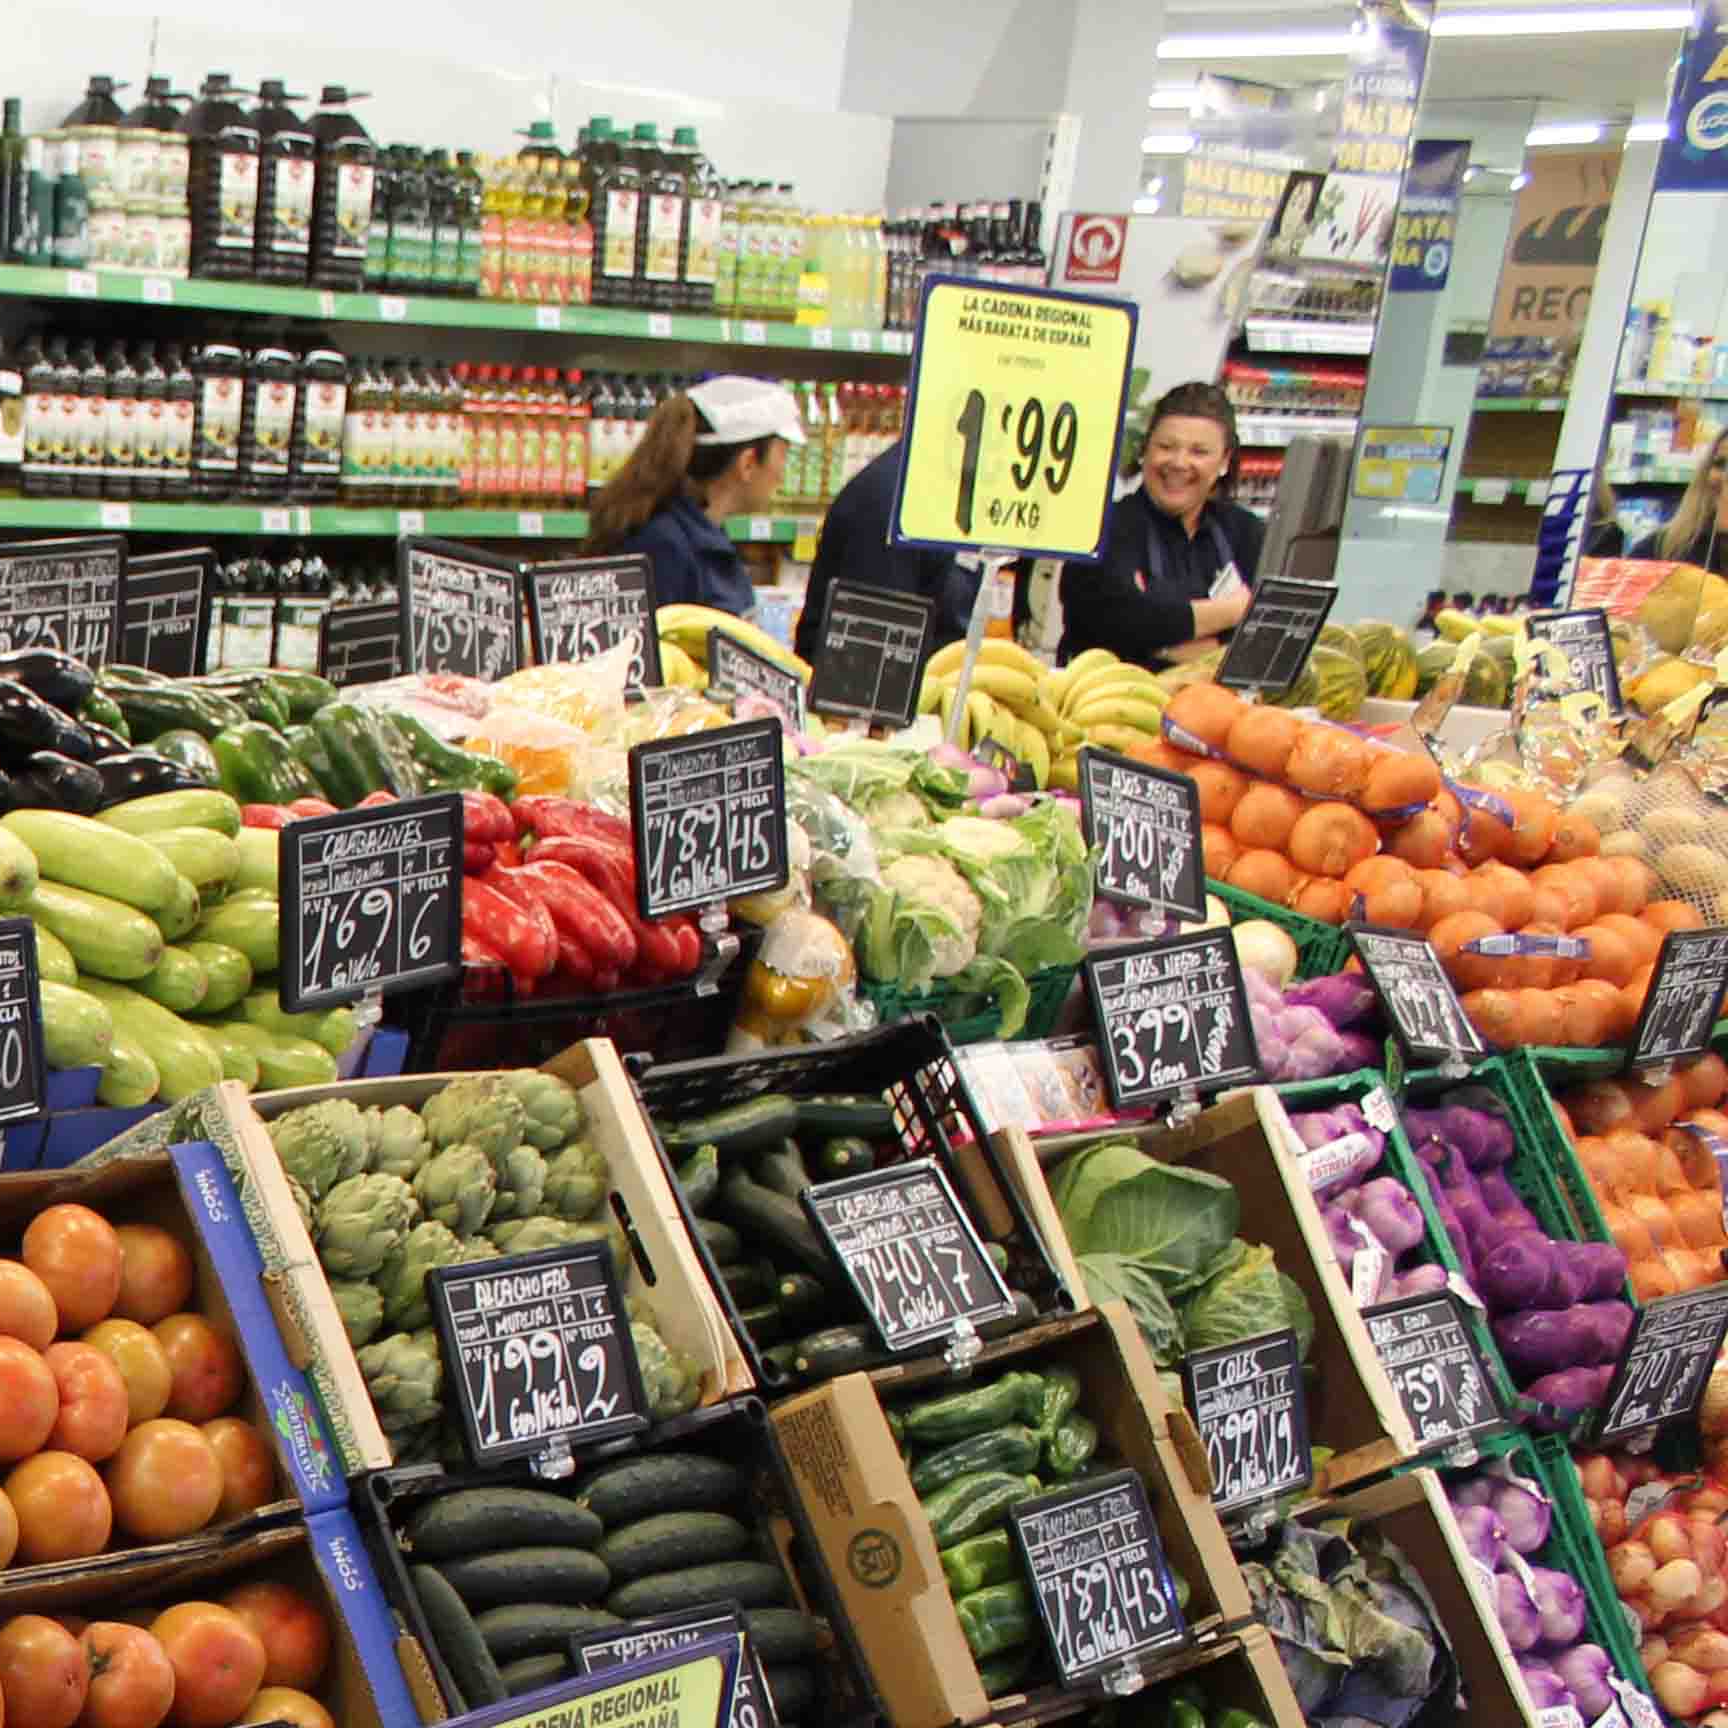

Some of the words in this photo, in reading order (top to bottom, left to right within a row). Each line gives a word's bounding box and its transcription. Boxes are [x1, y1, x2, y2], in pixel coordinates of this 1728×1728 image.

[963, 294, 978, 311] LA
[982, 299, 1032, 319] CADENA
[1035, 308, 1093, 328] REGIONAL
[984, 321, 1031, 339] BARATA
[1033, 324, 1046, 341] DE
[988, 498, 1041, 529] €/KG
[409, 893, 439, 960] 6
[580, 1323, 614, 1341] TECLA
[578, 1345, 618, 1419] 2
[1120, 1567, 1167, 1629] 43
[589, 1676, 681, 1725] REGIONAL
